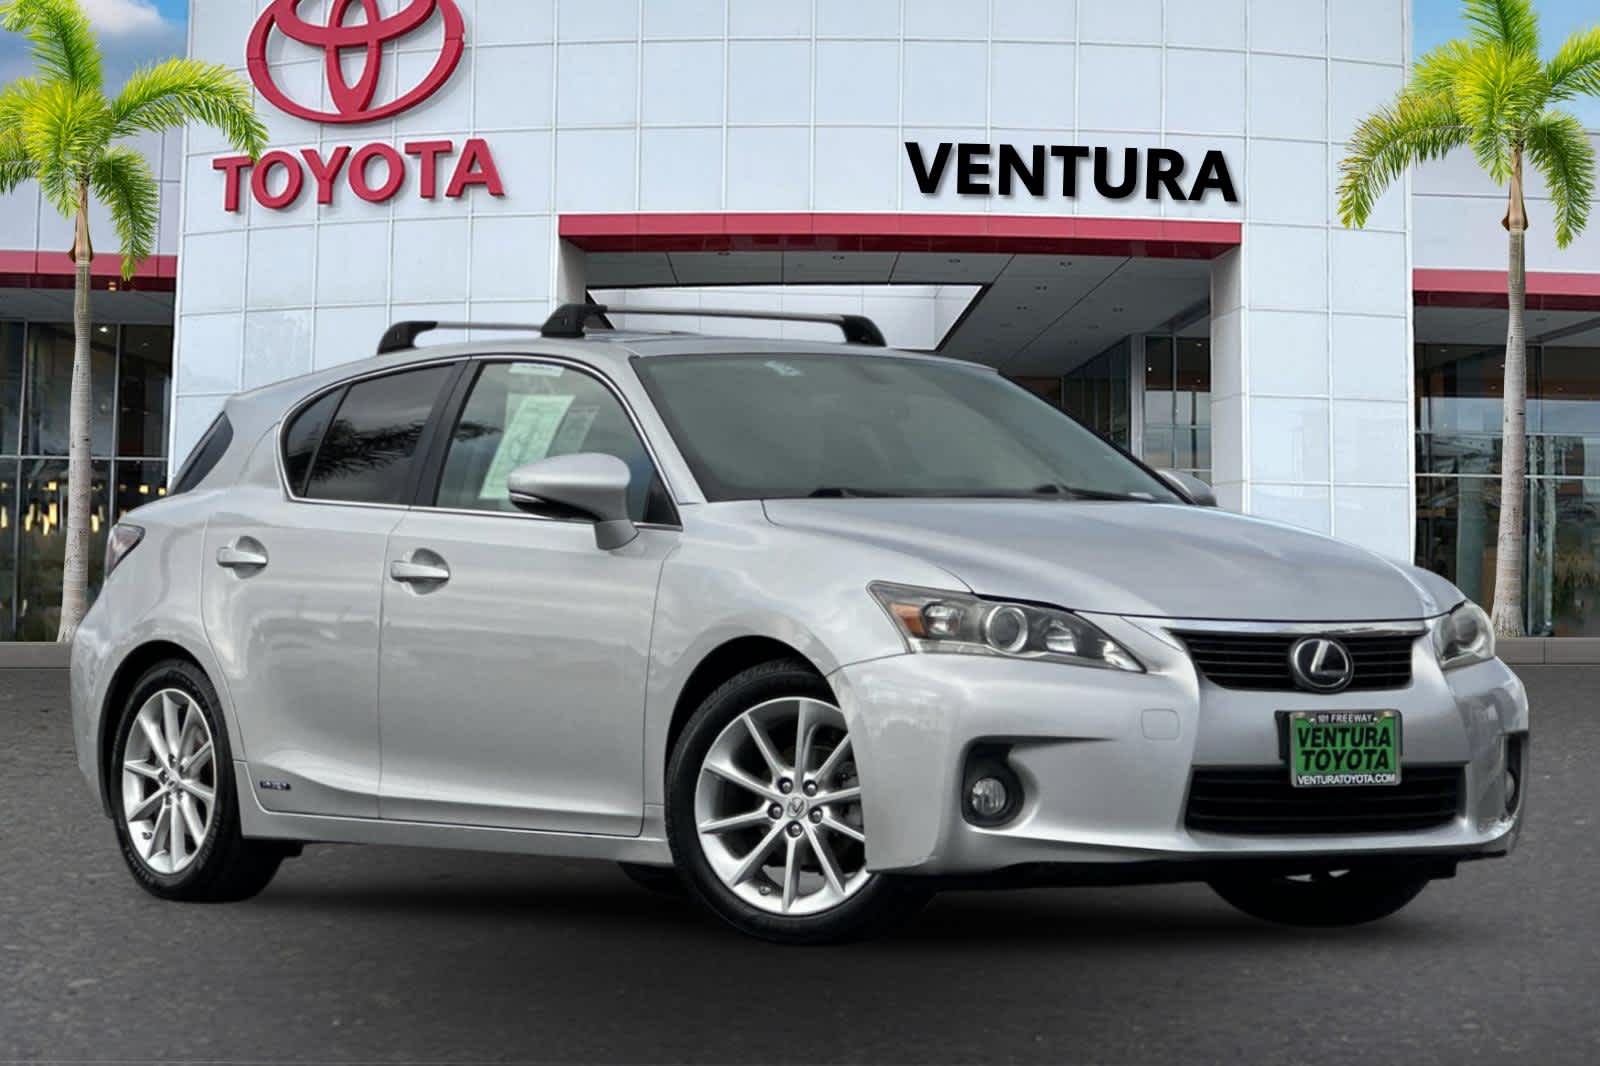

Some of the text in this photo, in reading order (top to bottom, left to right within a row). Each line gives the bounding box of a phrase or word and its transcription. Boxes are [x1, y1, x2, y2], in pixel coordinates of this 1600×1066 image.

[212, 138, 505, 212] TOYOTA
[905, 142, 1237, 203] VENTURA
[1297, 727, 1392, 748] VENTURA
[1302, 748, 1389, 771] TOYOTA
[1297, 773, 1396, 785] VENTURATOYOTA.COM
